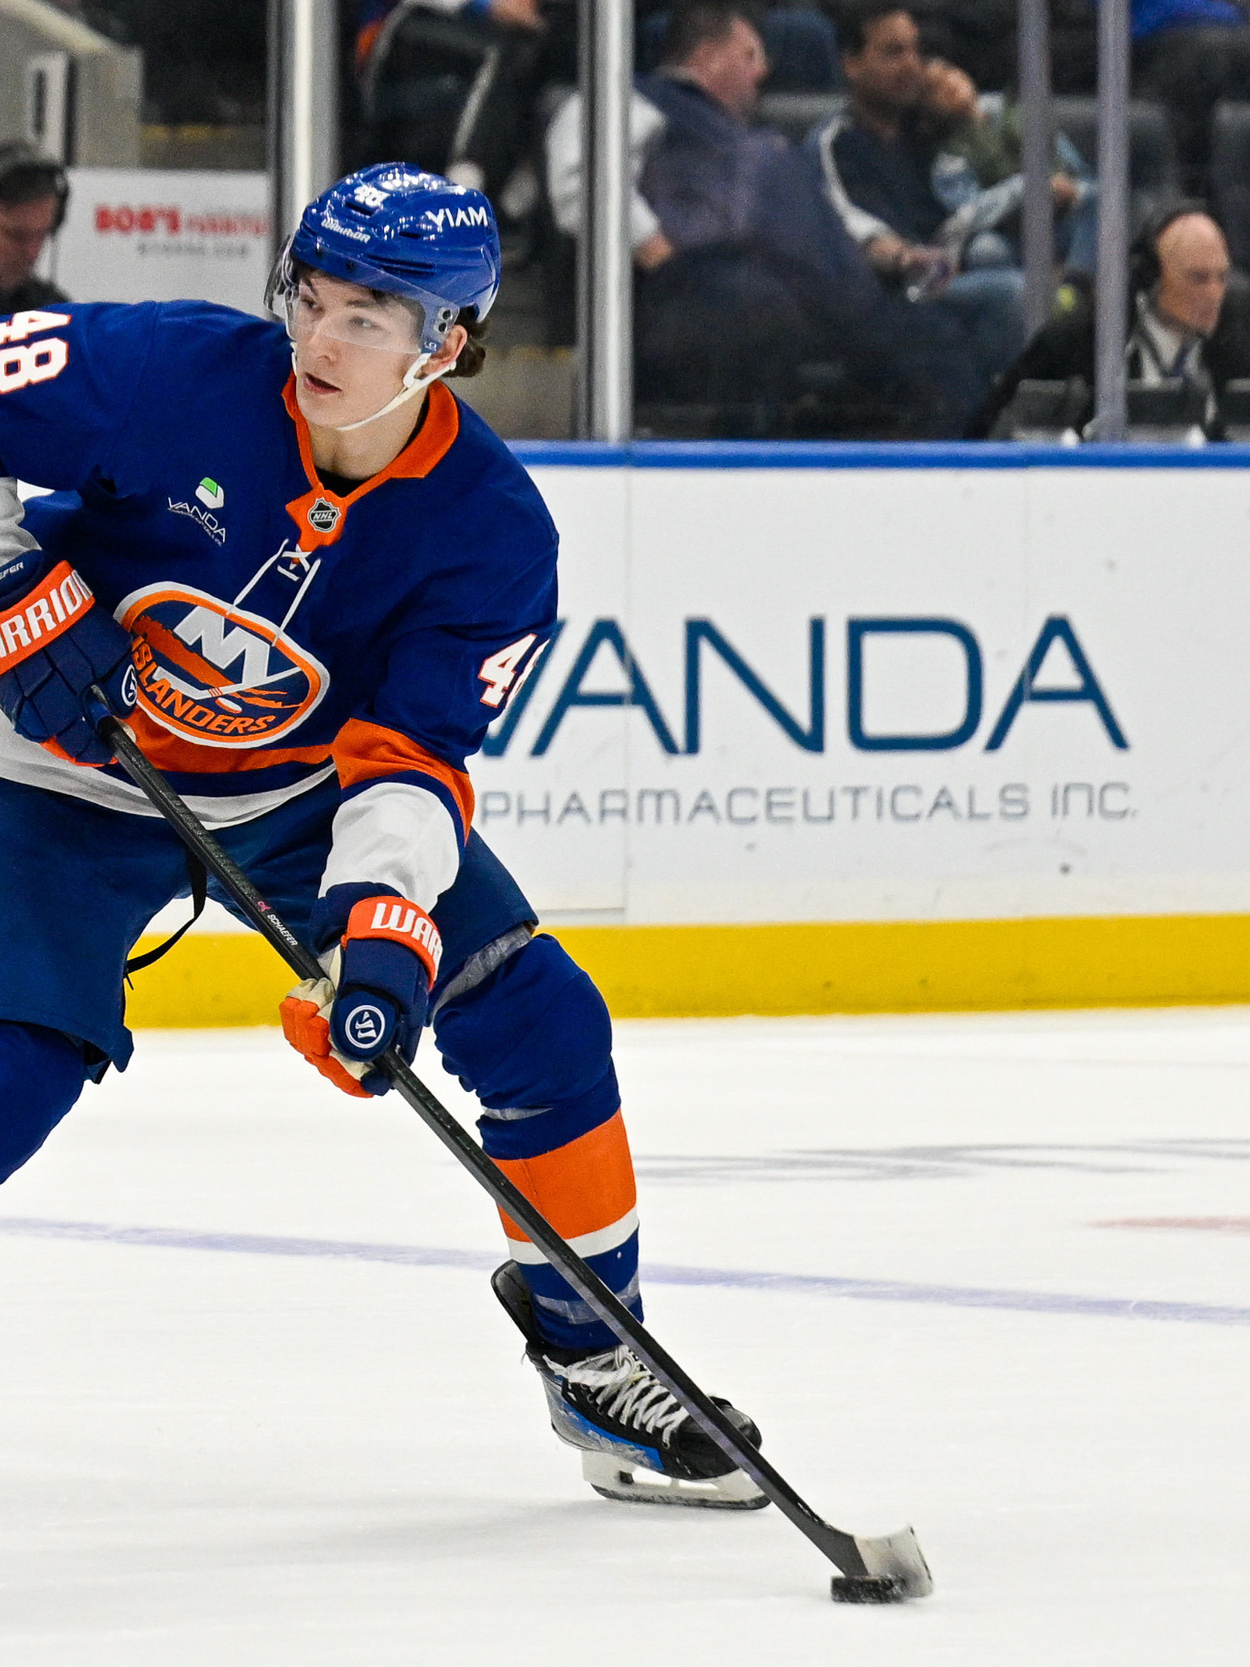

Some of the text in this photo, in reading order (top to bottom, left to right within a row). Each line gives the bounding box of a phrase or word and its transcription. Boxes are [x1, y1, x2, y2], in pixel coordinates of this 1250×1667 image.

[95, 204, 181, 234] BOB'S
[167, 497, 227, 543] VANDA
[312, 511, 336, 521] NHL
[130, 634, 277, 735] ISLANDERS
[481, 780, 1032, 826] PHARMACEUTICALS
[266, 914, 299, 946] SCHAEFER
